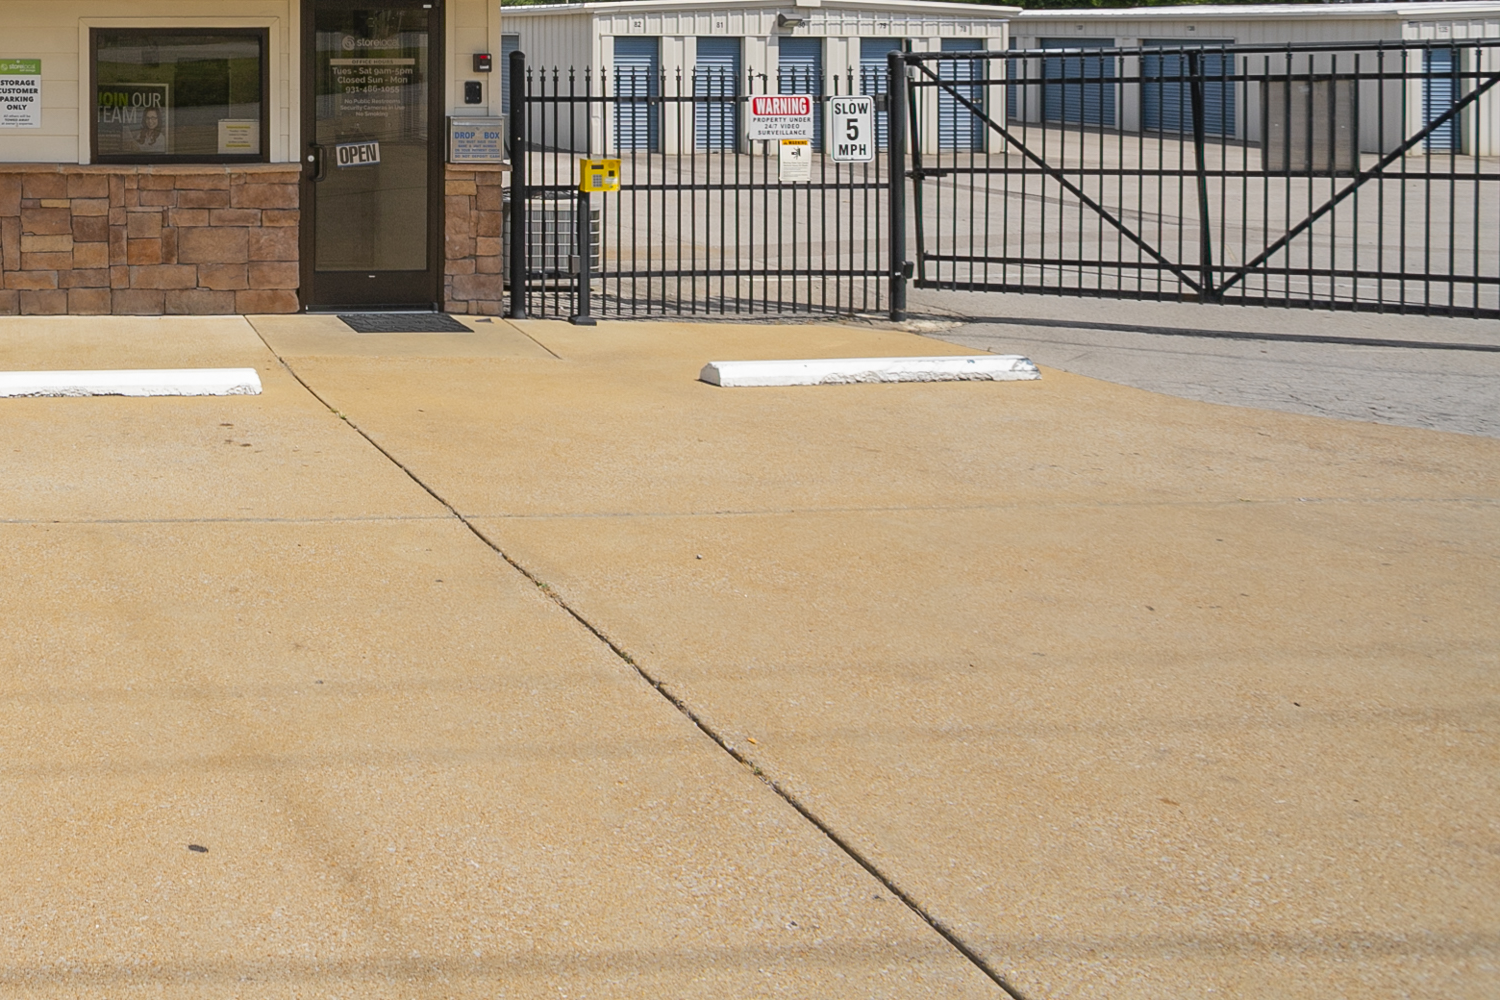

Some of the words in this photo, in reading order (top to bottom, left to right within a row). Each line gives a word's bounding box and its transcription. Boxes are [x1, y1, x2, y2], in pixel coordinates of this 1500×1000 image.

[357, 37, 400, 47] storelocal
[333, 67, 352, 75] Tues
[359, 67, 372, 75] Sat
[98, 92, 128, 106] JOIN
[132, 92, 161, 108] OUR
[756, 98, 807, 115] WARNING
[835, 103, 868, 114] SLOW
[846, 118, 859, 141] 5
[339, 144, 377, 164] OPEN
[839, 144, 866, 155] MPH
